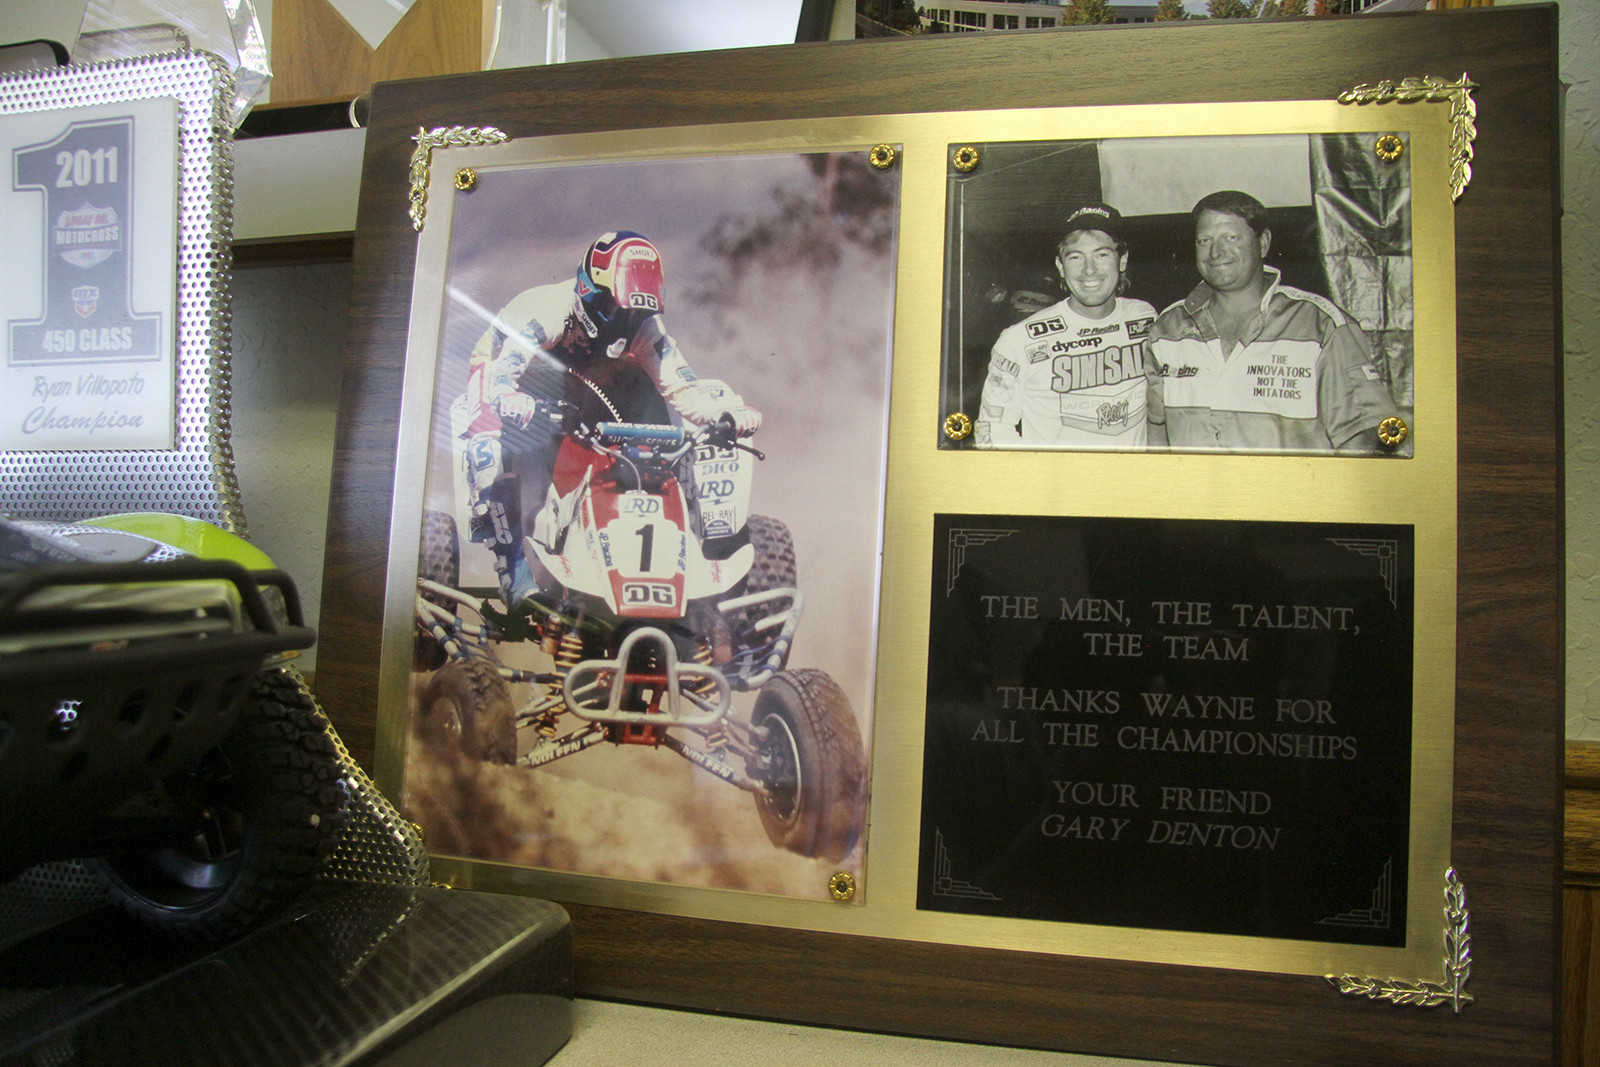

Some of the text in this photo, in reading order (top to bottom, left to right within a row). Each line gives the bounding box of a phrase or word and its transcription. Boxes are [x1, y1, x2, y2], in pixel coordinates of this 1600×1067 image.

[56, 147, 118, 188] 2011
[56, 226, 119, 245] MOTOCROSS
[581, 313, 597, 335] SHOEI
[1028, 320, 1066, 337] DG
[1091, 323, 1120, 334] Racing
[43, 327, 133, 353] 450 CLASS
[1051, 336, 1103, 353] dycorp
[1247, 366, 1312, 379] INNOVATORS
[1271, 354, 1289, 365] THE
[32, 374, 71, 403] Ryan
[1252, 387, 1302, 400] IMITATORS
[1256, 377, 1299, 389] NOT THE
[22, 405, 144, 435] Champion
[635, 523, 655, 573] 1
[624, 584, 674, 605] DG
[981, 596, 1361, 635] THE MEN, THE TALENT,
[1083, 633, 1250, 661] THE TEAM
[997, 686, 1336, 724] THANKS WAYNE FOR
[971, 720, 1358, 760] ALL THE CHAMPIONSHIPS
[1052, 780, 1272, 815] YOUR FRIEND
[1040, 814, 1282, 851] GARY DENTON
